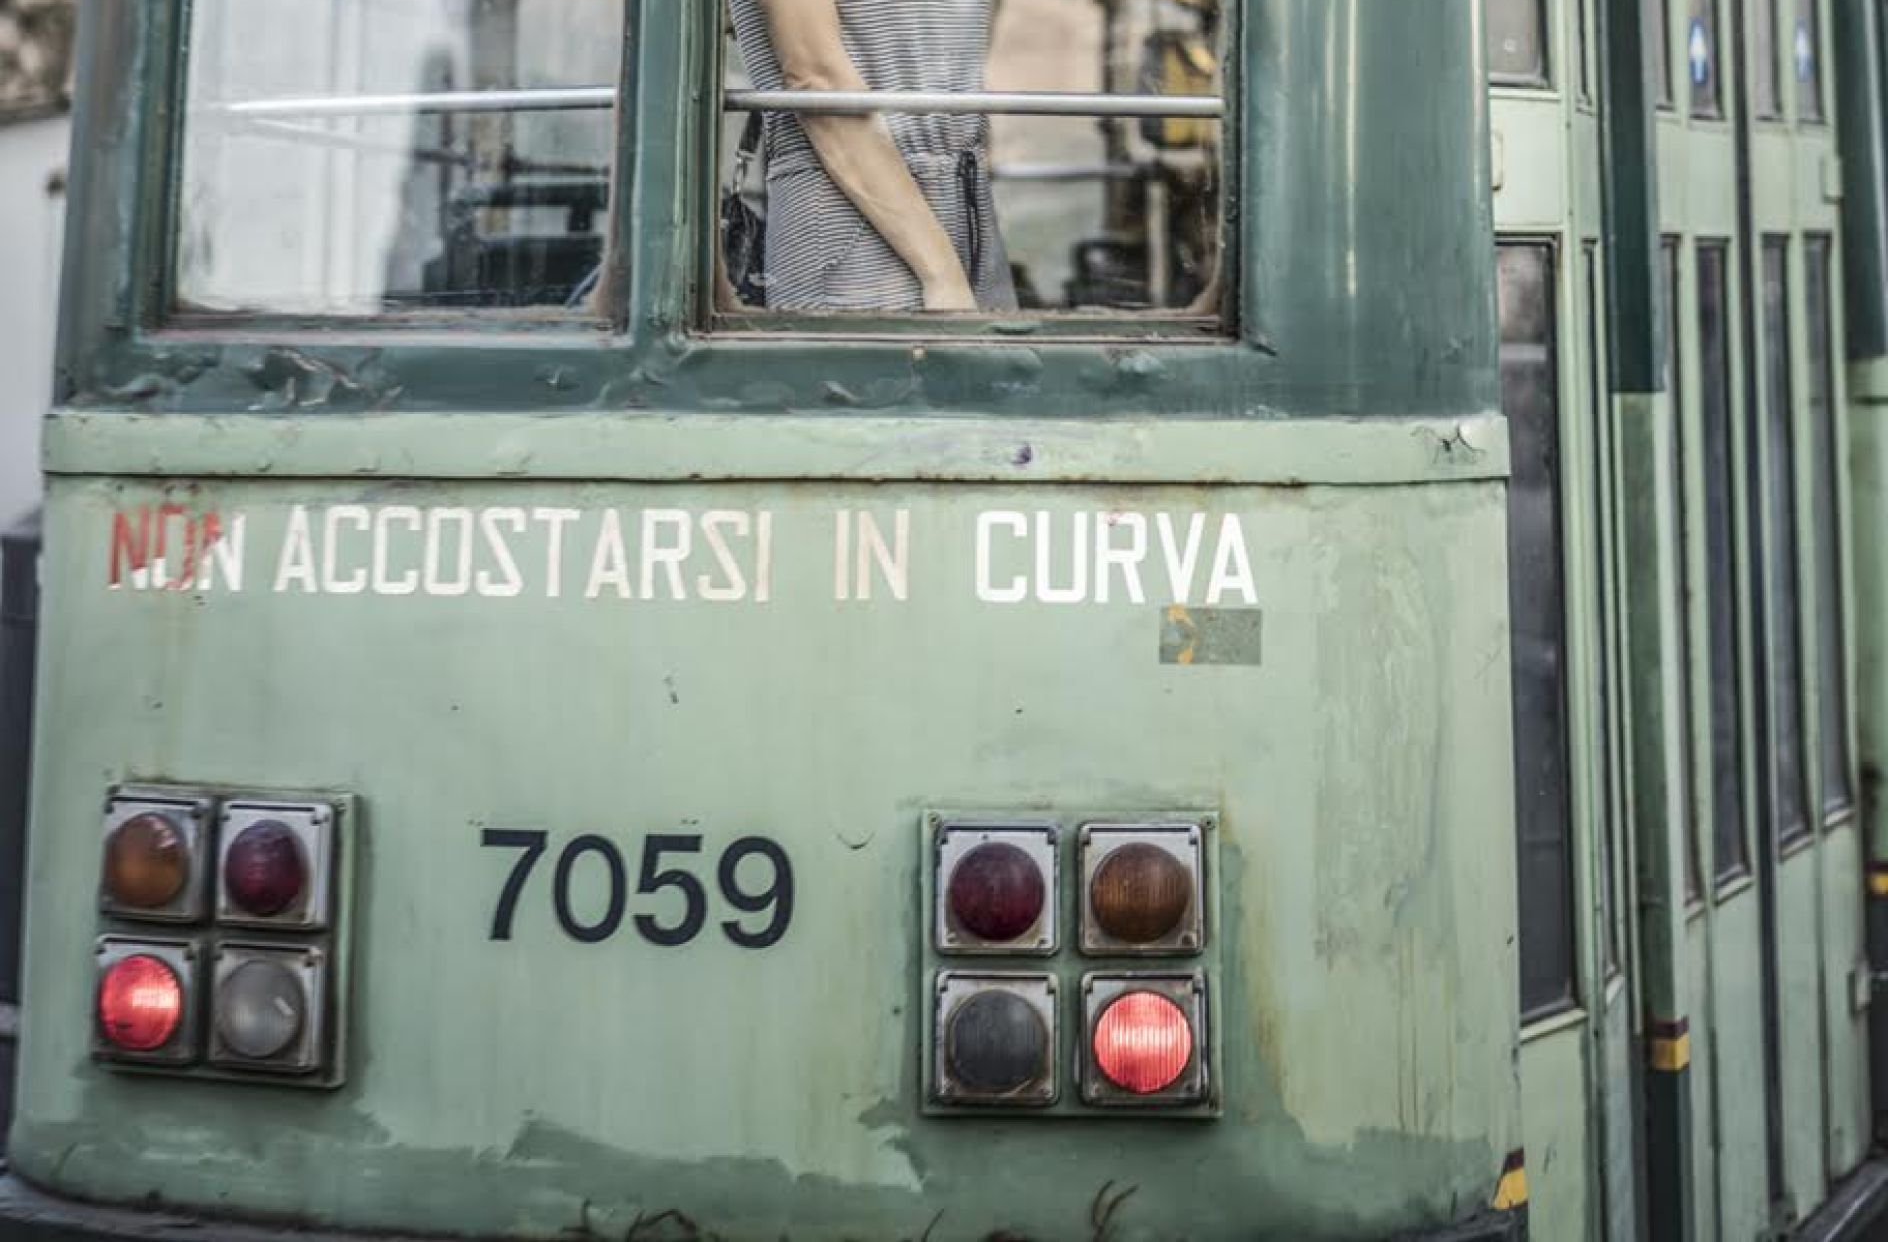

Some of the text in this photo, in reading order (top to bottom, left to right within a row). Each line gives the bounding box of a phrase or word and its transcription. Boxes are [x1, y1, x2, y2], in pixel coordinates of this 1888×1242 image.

[108, 503, 1259, 605] NON ACCOSTARSI IN CURVA
[480, 827, 794, 949] 7059
